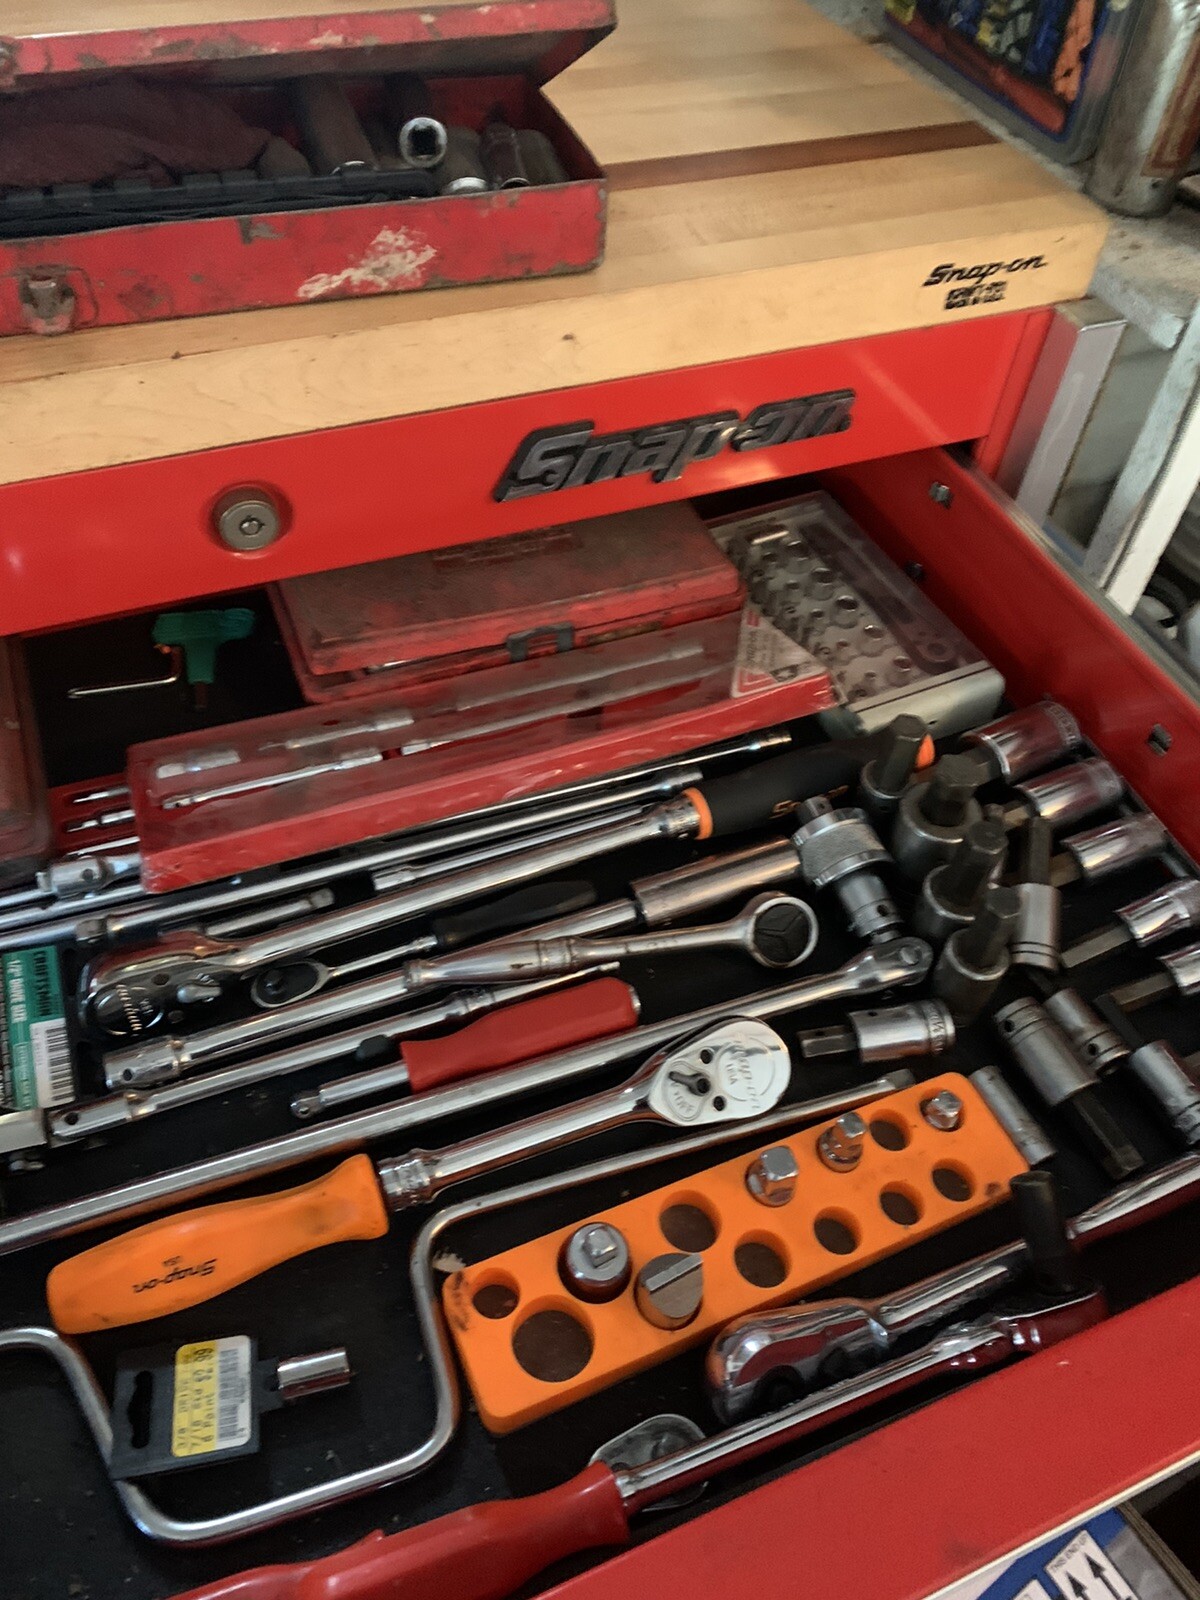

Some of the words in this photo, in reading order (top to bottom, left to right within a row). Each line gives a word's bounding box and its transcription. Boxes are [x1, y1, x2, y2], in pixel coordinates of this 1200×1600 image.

[922, 254, 1048, 286] Snap-on
[493, 388, 854, 502] Snap-on
[9, 977, 26, 1005] DRIVE
[33, 951, 51, 1016] CRAFTSMAN
[11, 1004, 28, 1024] SIZE
[132, 1258, 218, 1293] Snap-on
